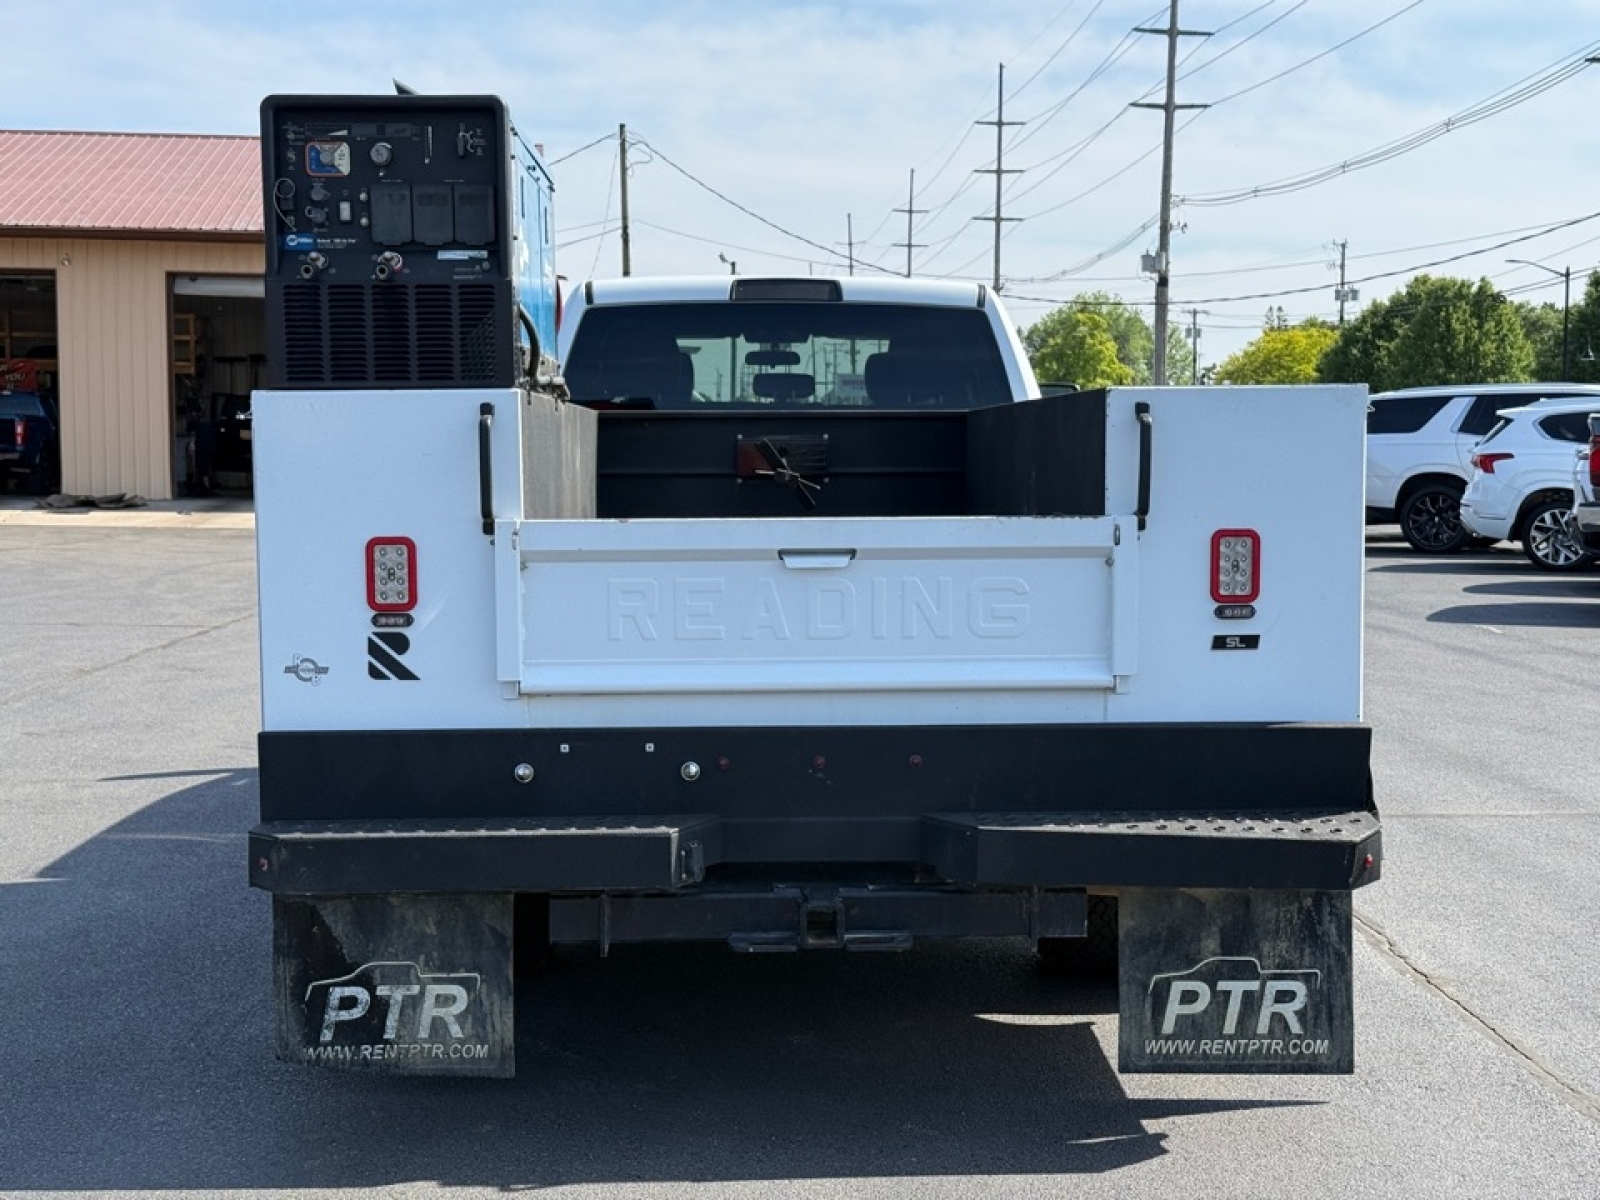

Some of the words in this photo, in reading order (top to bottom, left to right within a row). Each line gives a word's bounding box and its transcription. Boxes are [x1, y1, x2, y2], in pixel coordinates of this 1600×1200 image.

[607, 576, 1031, 642] READING
[1226, 637, 1246, 648] SL
[319, 984, 469, 1042] PTR
[1161, 980, 1308, 1035] PTR
[304, 1044, 490, 1060] WWW.RENTPTR.COM
[1145, 1039, 1330, 1055] WWW.RENTPTR.COM
